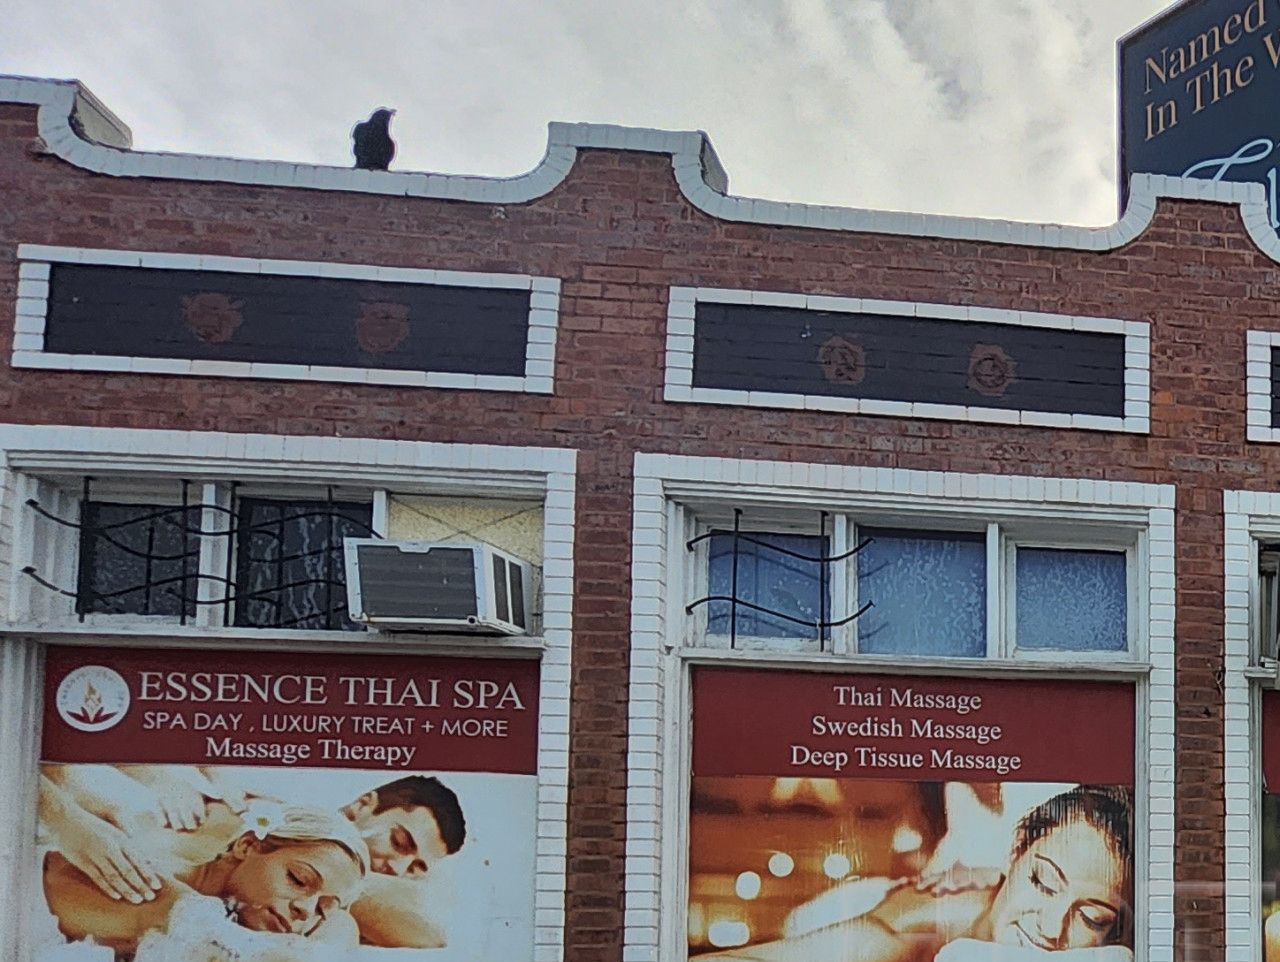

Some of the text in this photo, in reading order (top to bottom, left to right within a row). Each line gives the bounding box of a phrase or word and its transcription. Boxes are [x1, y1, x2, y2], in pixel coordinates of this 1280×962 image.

[1144, 0, 1267, 94] Named
[1144, 99, 1178, 142] In
[1186, 55, 1255, 115] The
[138, 672, 327, 703] ESSENCE
[340, 677, 440, 707] THAI
[454, 681, 525, 709] SPA
[834, 687, 981, 714] Thai Massage
[144, 712, 187, 729] SPA
[194, 713, 242, 730] DAY
[263, 715, 345, 732] LUXURY
[351, 717, 415, 734] TREAT
[442, 719, 507, 736] MORE
[813, 716, 1001, 744] Swedish Massage
[207, 737, 415, 765] Massage Therapy
[792, 746, 1020, 774] Deep Tissue Massage
